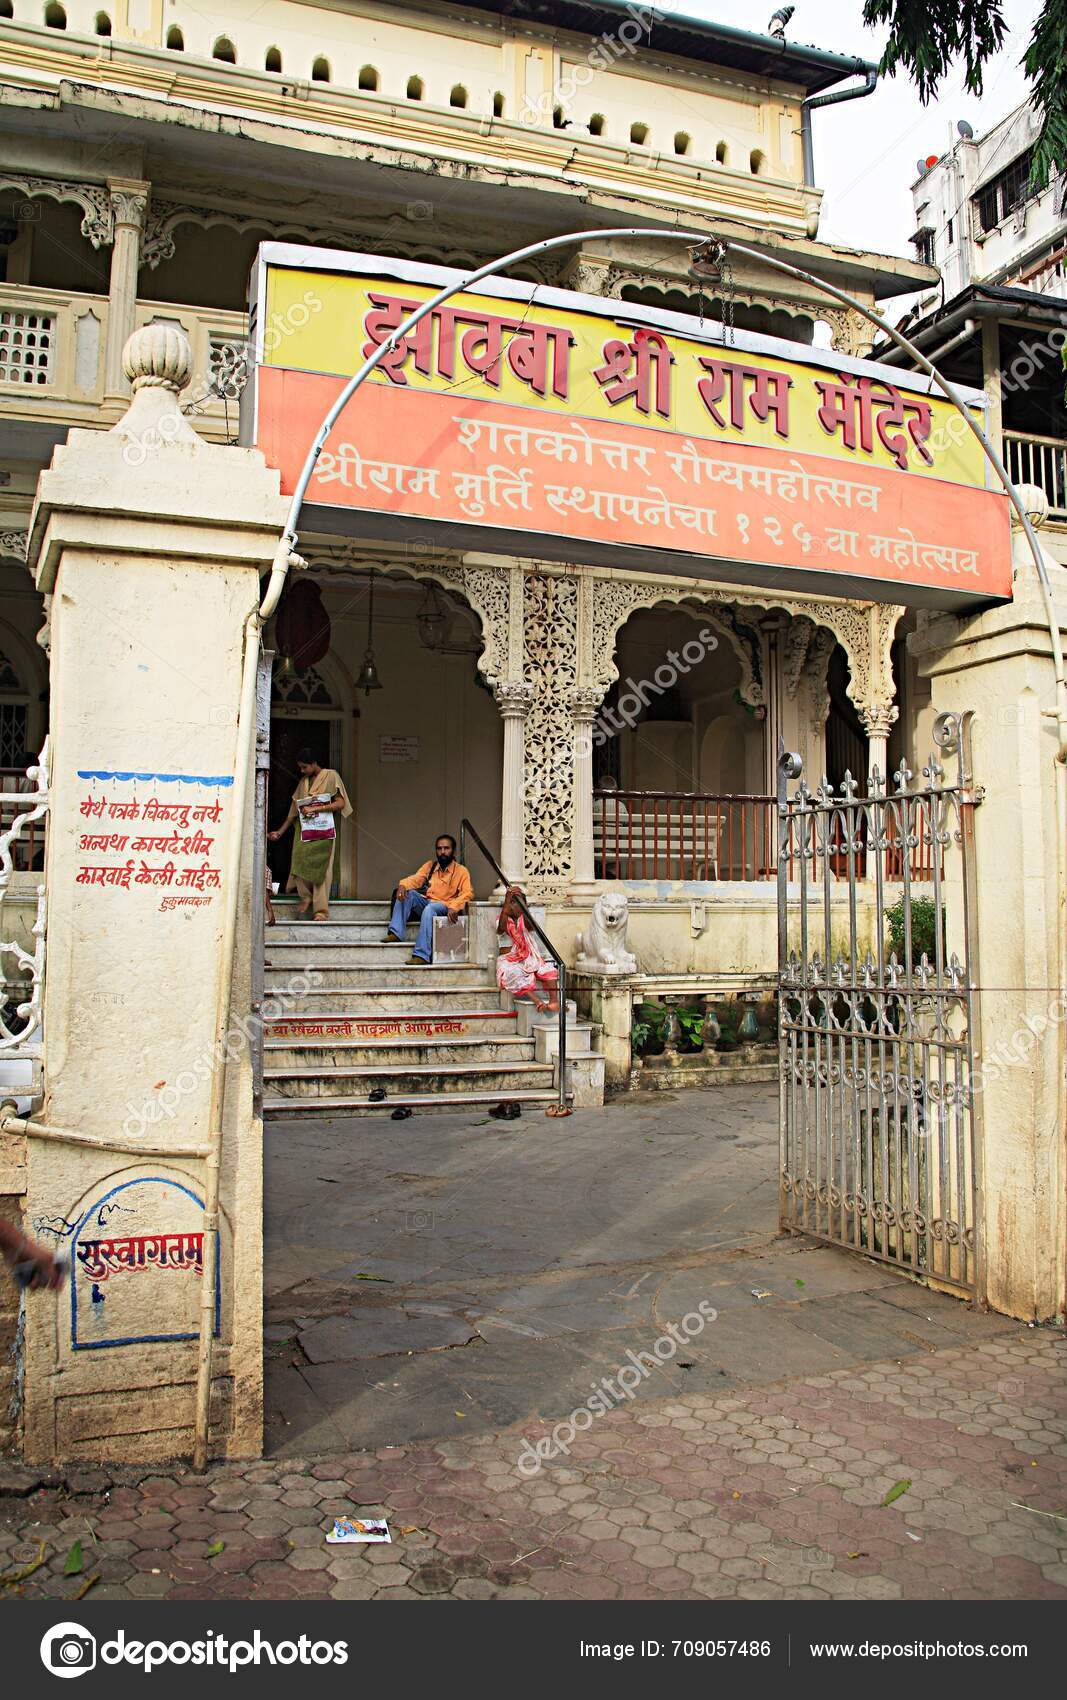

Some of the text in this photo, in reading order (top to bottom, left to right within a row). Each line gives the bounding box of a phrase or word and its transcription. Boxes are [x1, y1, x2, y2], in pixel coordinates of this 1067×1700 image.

[361, 290, 935, 471] झावबा श्री राम मंदिर
[451, 416, 882, 513] शतकोत्तर रौप्यमहोत्सव
[311, 442, 442, 499] श्रीराम
[451, 464, 534, 516] मुर्ति
[543, 484, 719, 537] स्थापनेचा
[824, 526, 861, 559] वा
[867, 526, 981, 577] महोत्सव
[79, 794, 108, 820] येथे
[108, 796, 141, 820] पत्रके
[79, 833, 130, 853] अन्यथा
[134, 859, 177, 887] केली
